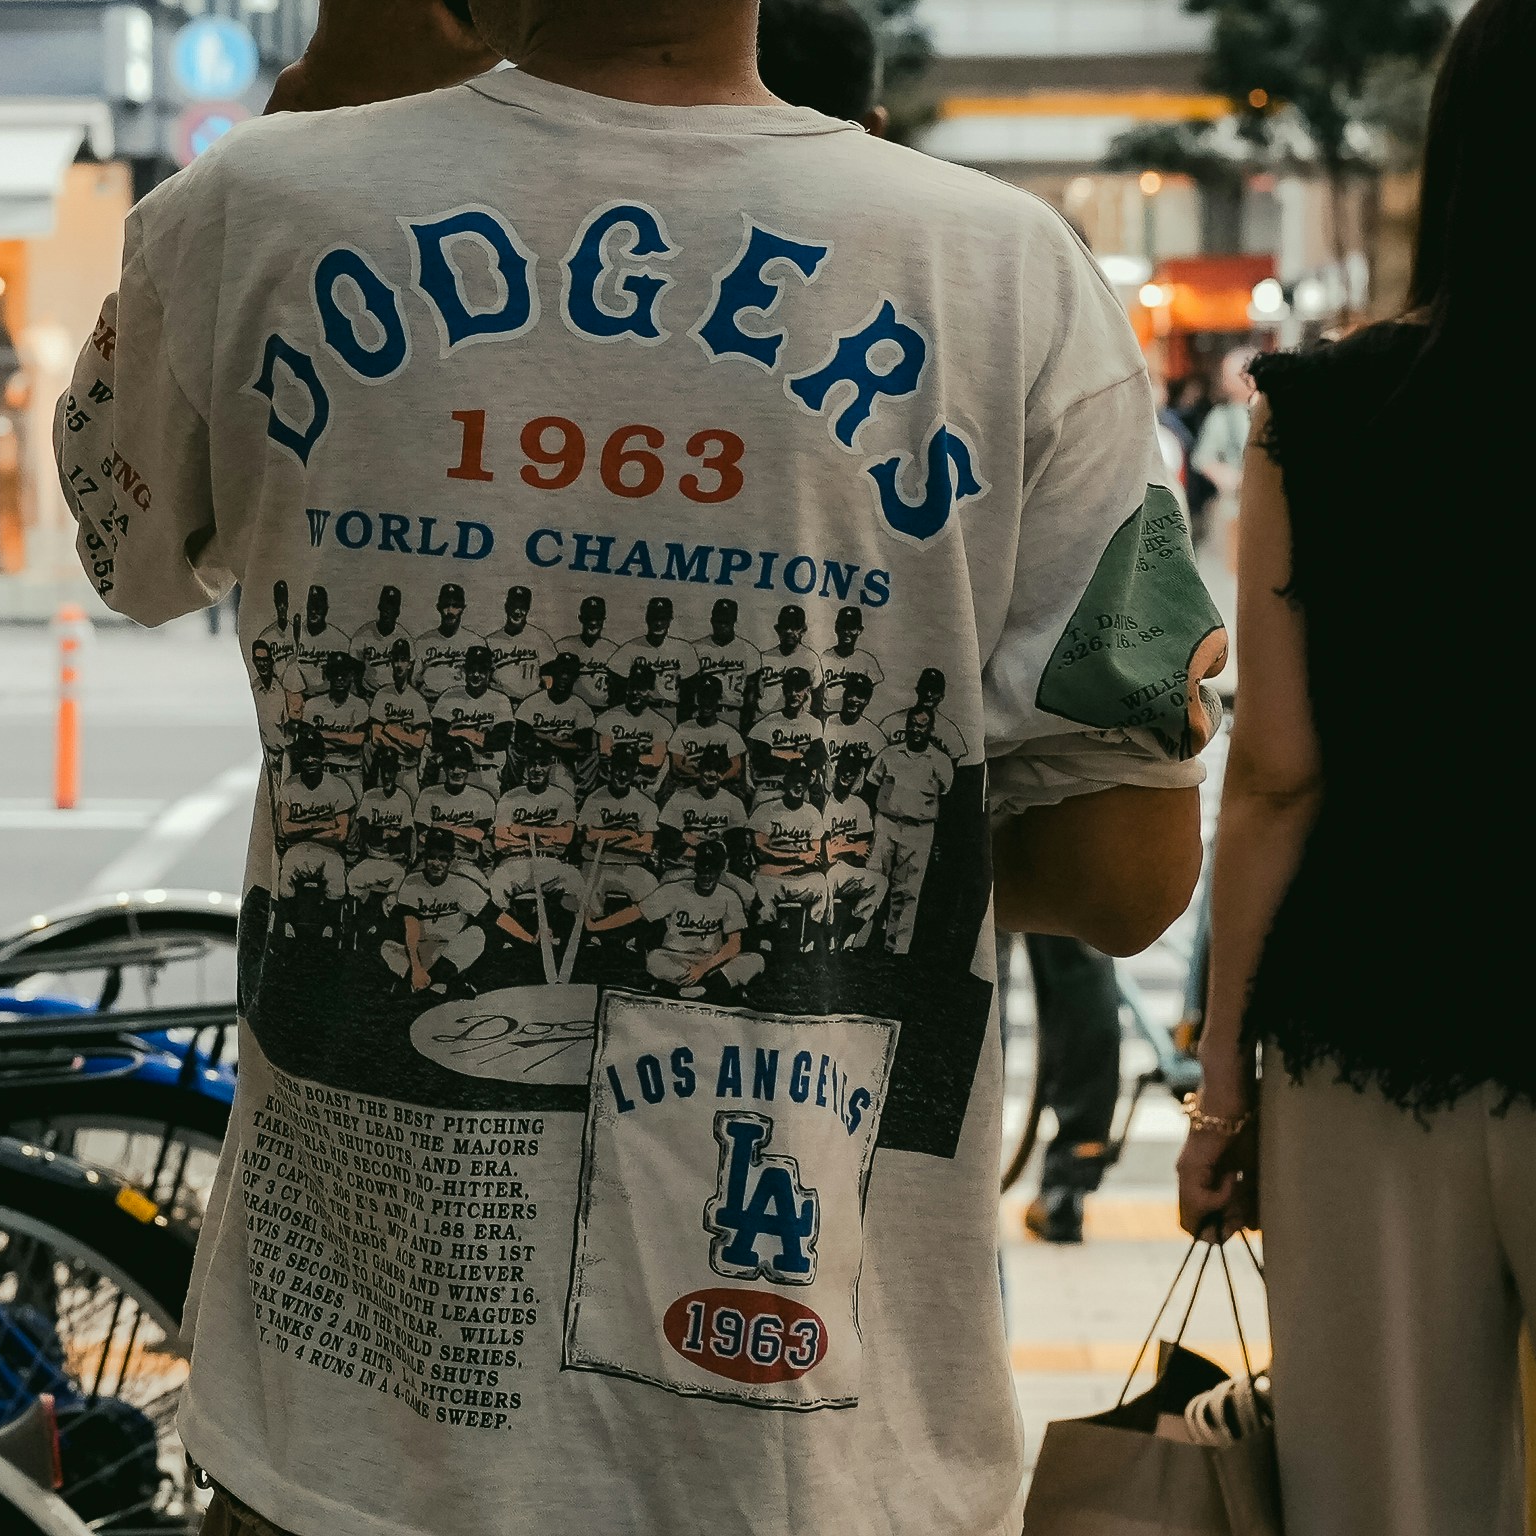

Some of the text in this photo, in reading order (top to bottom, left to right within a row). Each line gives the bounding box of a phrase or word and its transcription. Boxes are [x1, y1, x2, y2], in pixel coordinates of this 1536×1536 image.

[242, 200, 990, 549] DODGERS
[447, 408, 746, 504] 1963
[306, 508, 892, 608] WORLD CHAMPIONS
[1121, 669, 1188, 710] WILLS
[305, 1085, 351, 1111] BOAST
[356, 1098, 388, 1119] THE
[393, 1106, 435, 1130] BEST
[443, 1116, 545, 1135] PITCHING
[606, 1047, 696, 1113] LOS
[252, 1111, 295, 1141] TAKES
[347, 1172, 398, 1198] CROWN
[403, 1187, 424, 1211] FOR
[431, 1199, 538, 1219] PITCHERS
[323, 1108, 360, 1132] THEY
[365, 1119, 404, 1142] LEAD
[410, 1131, 444, 1152] THE
[453, 1138, 539, 1156] MAJORS
[330, 1144, 349, 1166] HIS
[354, 1155, 411, 1184] SECOND
[415, 1172, 529, 1200] NO-HITTER,
[338, 1131, 416, 1169] SHUTOUTS,
[422, 1156, 461, 1175] AND
[469, 1160, 518, 1177] ERA.
[241, 1149, 271, 1171] AND
[328, 1198, 350, 1222] THE
[388, 1221, 408, 1243] MVP
[410, 1235, 442, 1256] AND
[450, 1243, 488, 1261] HIS
[499, 1245, 536, 1262] 1ST
[242, 1169, 260, 1189] OF
[265, 1179, 276, 1195] 3
[281, 1185, 302, 1204] CY
[395, 1246, 416, 1269] ACE
[422, 1258, 524, 1282] RELIEVER
[257, 1133, 295, 1161] WITH
[355, 1193, 378, 1213] K'S
[384, 1202, 407, 1223] AND
[410, 1213, 417, 1229] A
[424, 1218, 465, 1238] 1.88
[474, 1224, 522, 1242] ERA,
[716, 1120, 817, 1272] LA
[253, 1238, 281, 1262] THE
[286, 1253, 349, 1289] SECOND
[352, 1279, 399, 1321] STRAIGHT
[402, 1310, 442, 1339] YEAR.
[460, 1327, 524, 1346] WILLS
[269, 1267, 286, 1285] 40
[289, 1276, 346, 1310] BASES.
[357, 1301, 369, 1321] IN
[373, 1310, 392, 1335] THE
[395, 1325, 432, 1356] WORLD
[439, 1345, 522, 1369] SERIES,
[283, 1229, 324, 1258] HITS
[352, 1264, 368, 1281] TO
[372, 1272, 396, 1299] LEAD
[400, 1288, 435, 1316] BOTH
[441, 1304, 537, 1325] LEAGUES
[352, 1246, 368, 1264] 21
[373, 1254, 406, 1284] GAMES
[409, 1274, 439, 1297] AND
[511, 1287, 540, 1304] 16.
[268, 1308, 314, 1341] YANKS
[319, 1331, 344, 1352] ON
[347, 1342, 358, 1358] 3
[361, 1347, 395, 1375] HITS.
[421, 1381, 522, 1409] PITCHERS
[276, 1334, 288, 1353] TO
[295, 1345, 305, 1360] 4
[308, 1349, 355, 1379] RUNS
[358, 1368, 377, 1387] IN
[378, 1377, 388, 1393] A
[393, 1383, 430, 1419] 4-GAME
[436, 1407, 512, 1430] SWEEP.
[282, 1294, 324, 1322] WINS
[327, 1313, 339, 1328] 2
[342, 1319, 371, 1342] AND
[375, 1331, 425, 1376] DRYSDALE
[431, 1364, 499, 1387] SHUTS
[681, 1301, 821, 1370] 1963
